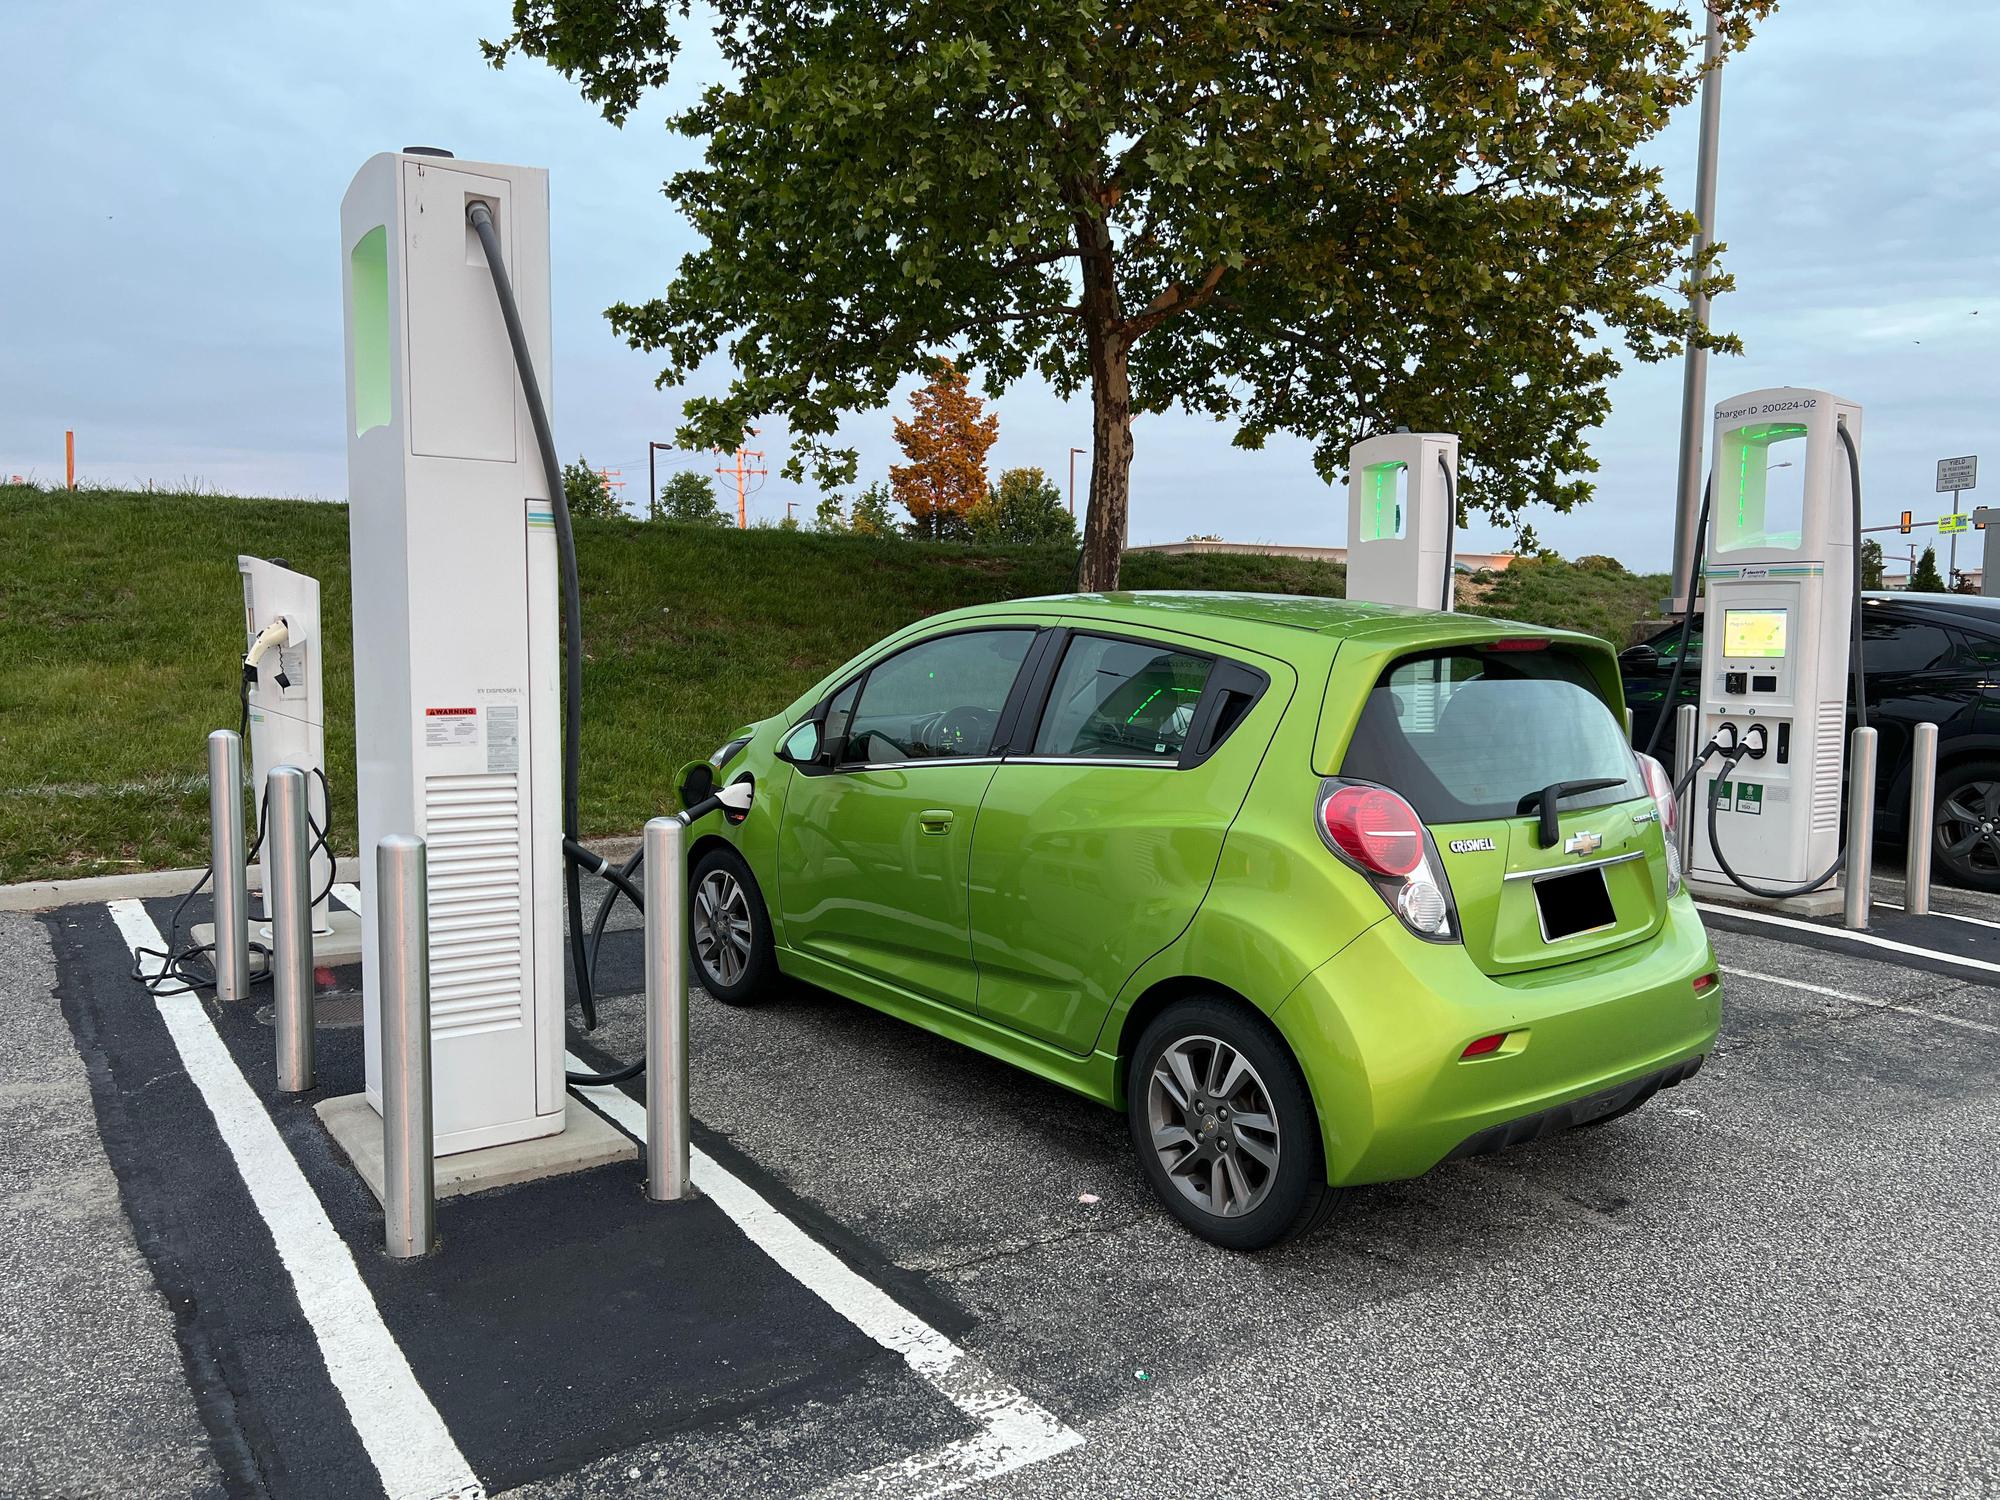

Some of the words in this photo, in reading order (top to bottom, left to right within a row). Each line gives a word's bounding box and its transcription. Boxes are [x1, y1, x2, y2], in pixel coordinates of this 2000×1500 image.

[1714, 408, 1747, 420] Charger
[1748, 406, 1758, 415] ID
[1762, 399, 1817, 414] 200224-02
